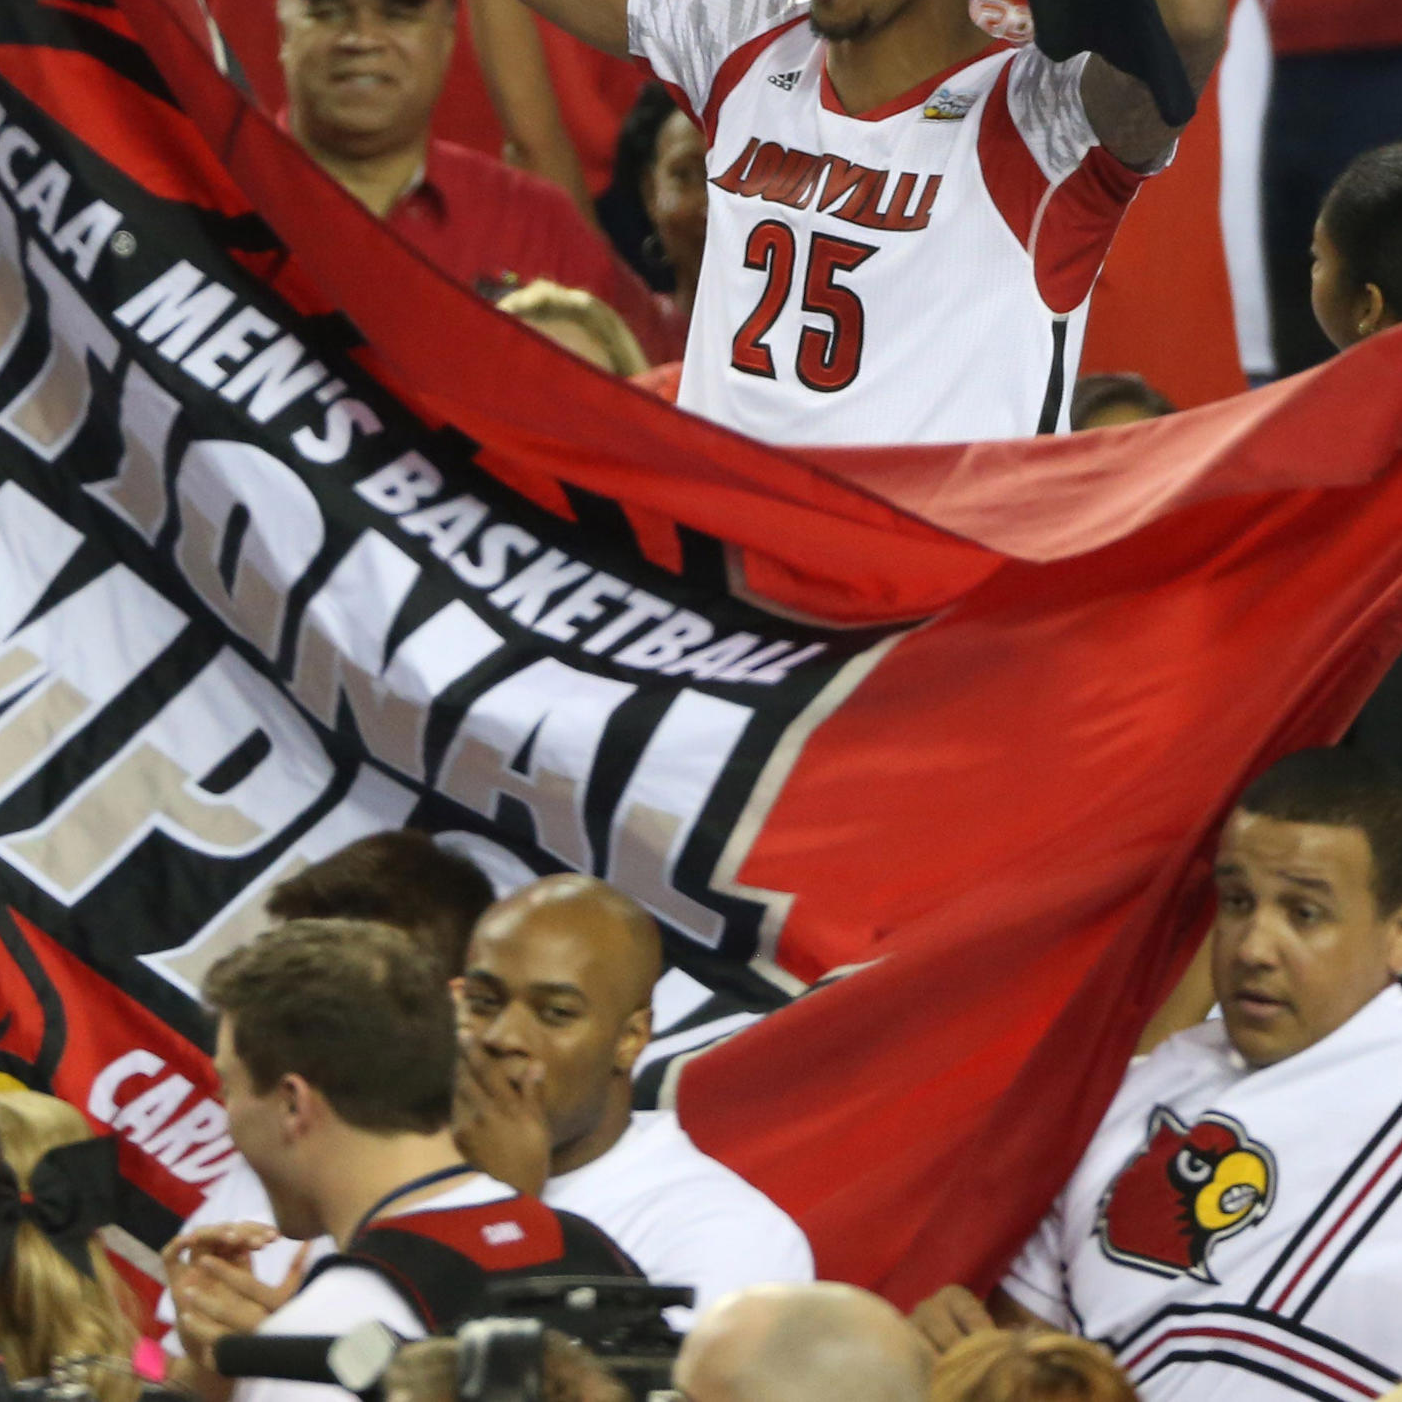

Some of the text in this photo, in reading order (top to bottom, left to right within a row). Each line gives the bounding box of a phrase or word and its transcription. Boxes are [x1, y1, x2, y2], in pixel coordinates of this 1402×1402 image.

[730, 219, 880, 393] 25
[112, 259, 382, 465] MEN'S
[354, 450, 828, 687] BASKETBALL
